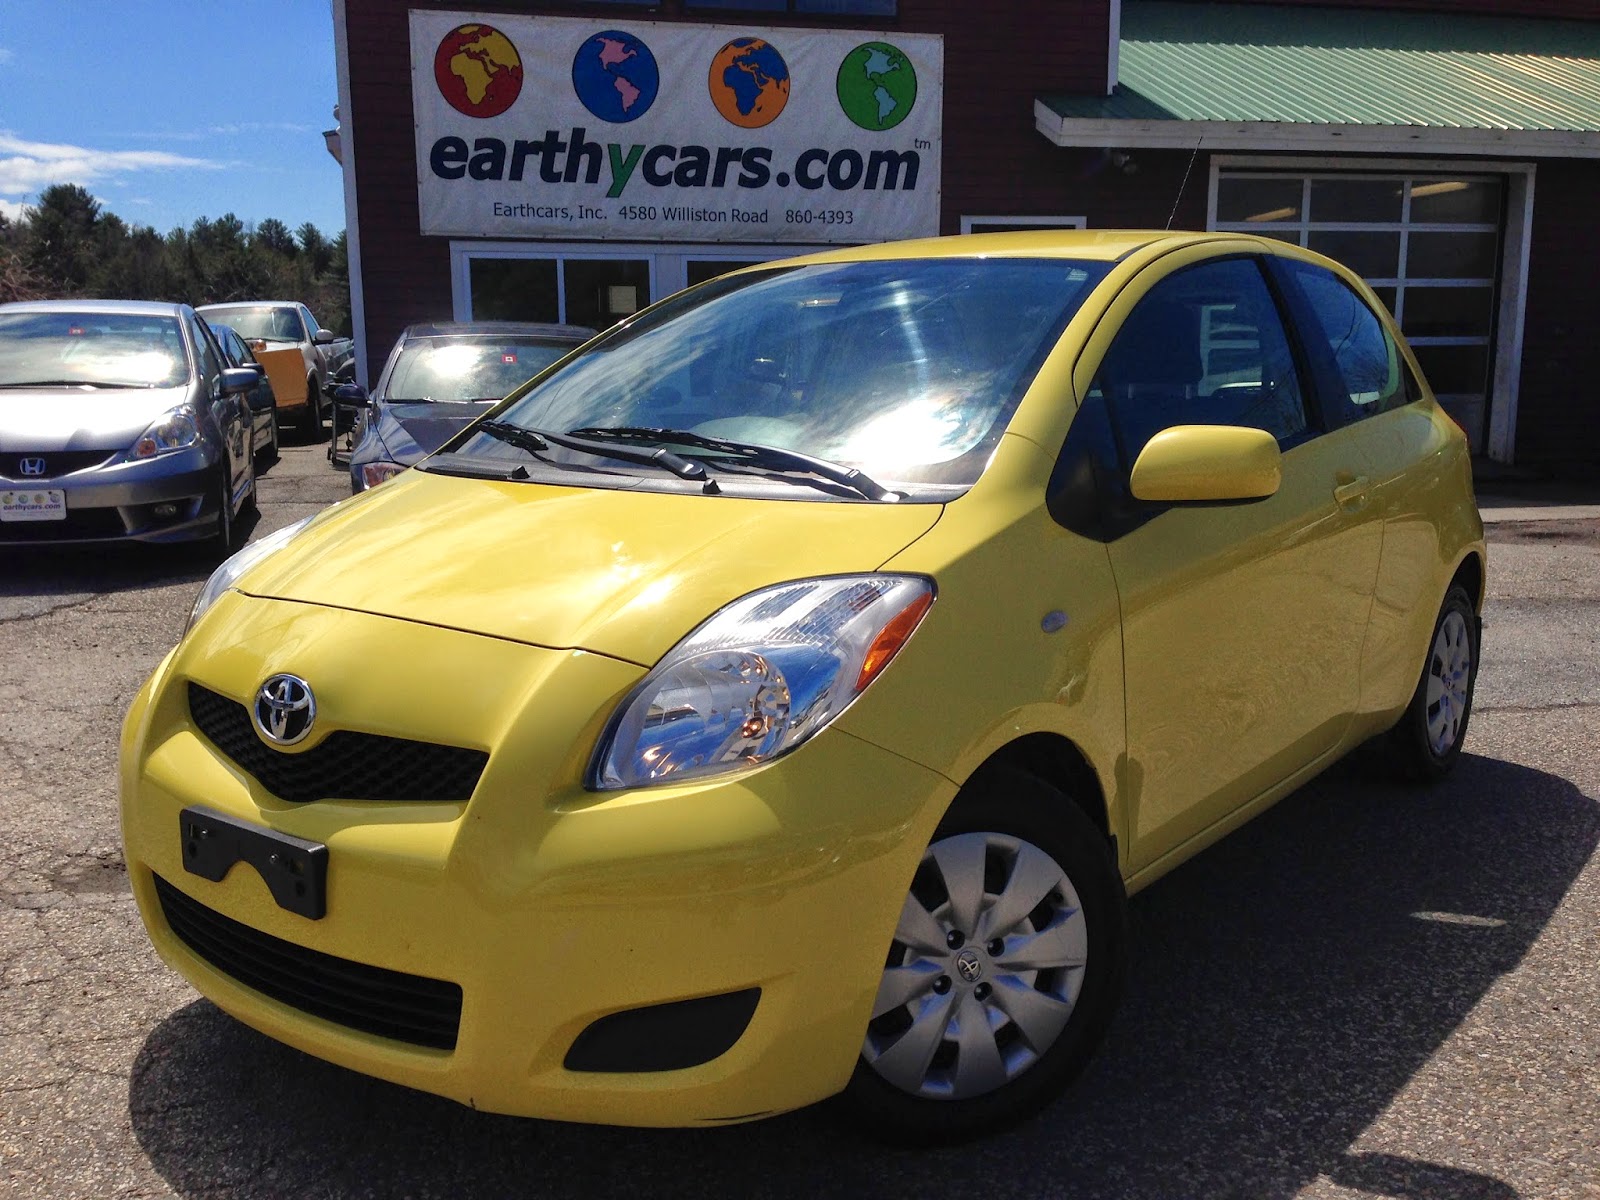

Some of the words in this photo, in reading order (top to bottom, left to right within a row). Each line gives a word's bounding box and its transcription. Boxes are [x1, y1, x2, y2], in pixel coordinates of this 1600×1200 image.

[429, 127, 920, 198] earthycars.com
[493, 202, 573, 221] Earthcars,
[578, 205, 607, 220] Inc.
[618, 205, 657, 220] 4580
[662, 206, 727, 222] Williston
[731, 208, 768, 223] Road
[785, 209, 854, 225] 860-4393
